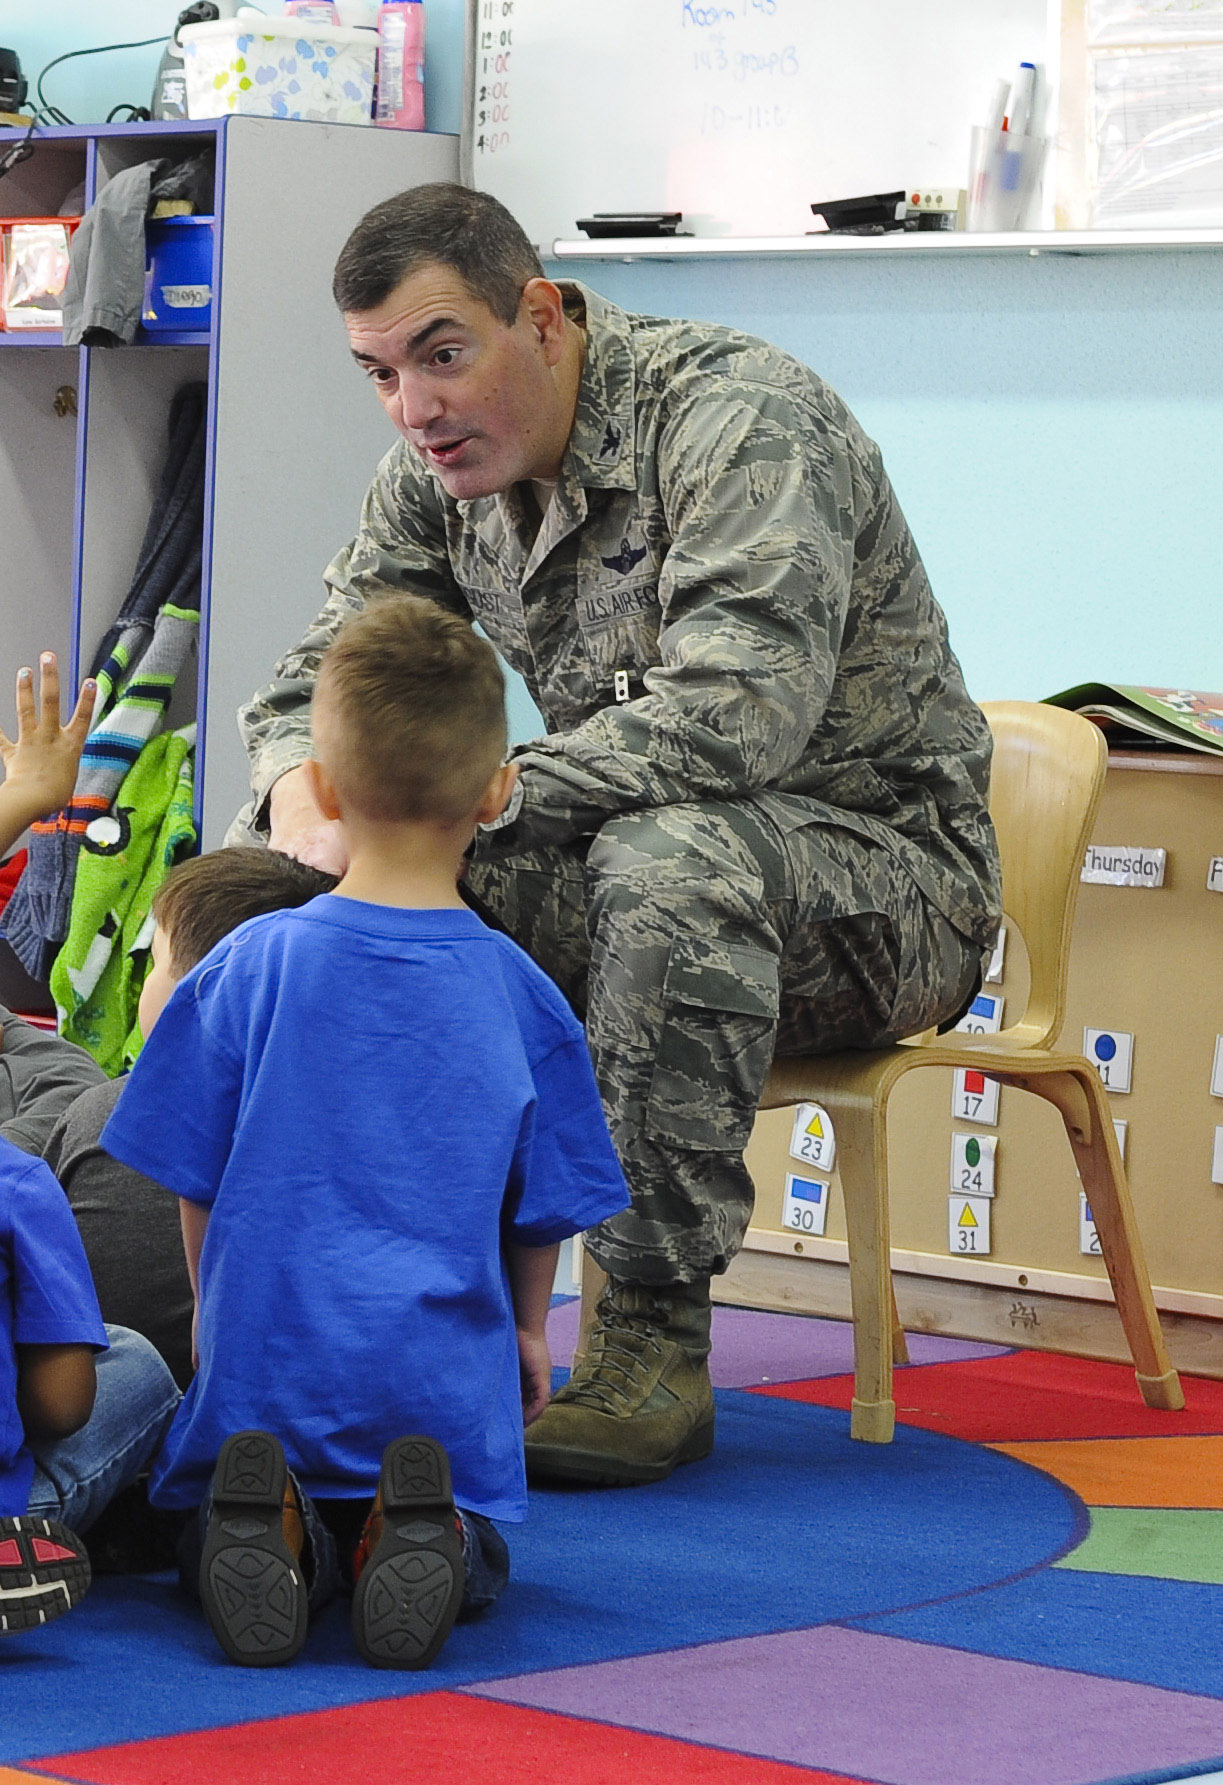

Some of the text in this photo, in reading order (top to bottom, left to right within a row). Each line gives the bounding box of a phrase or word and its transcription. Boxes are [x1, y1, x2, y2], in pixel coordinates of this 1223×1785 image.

[611, 590, 636, 616] AIR
[962, 1094, 983, 1117] 17
[801, 1136, 823, 1161] 23
[961, 1168, 982, 1192] 24
[791, 1206, 814, 1230] 30
[957, 1230, 977, 1251] 31
